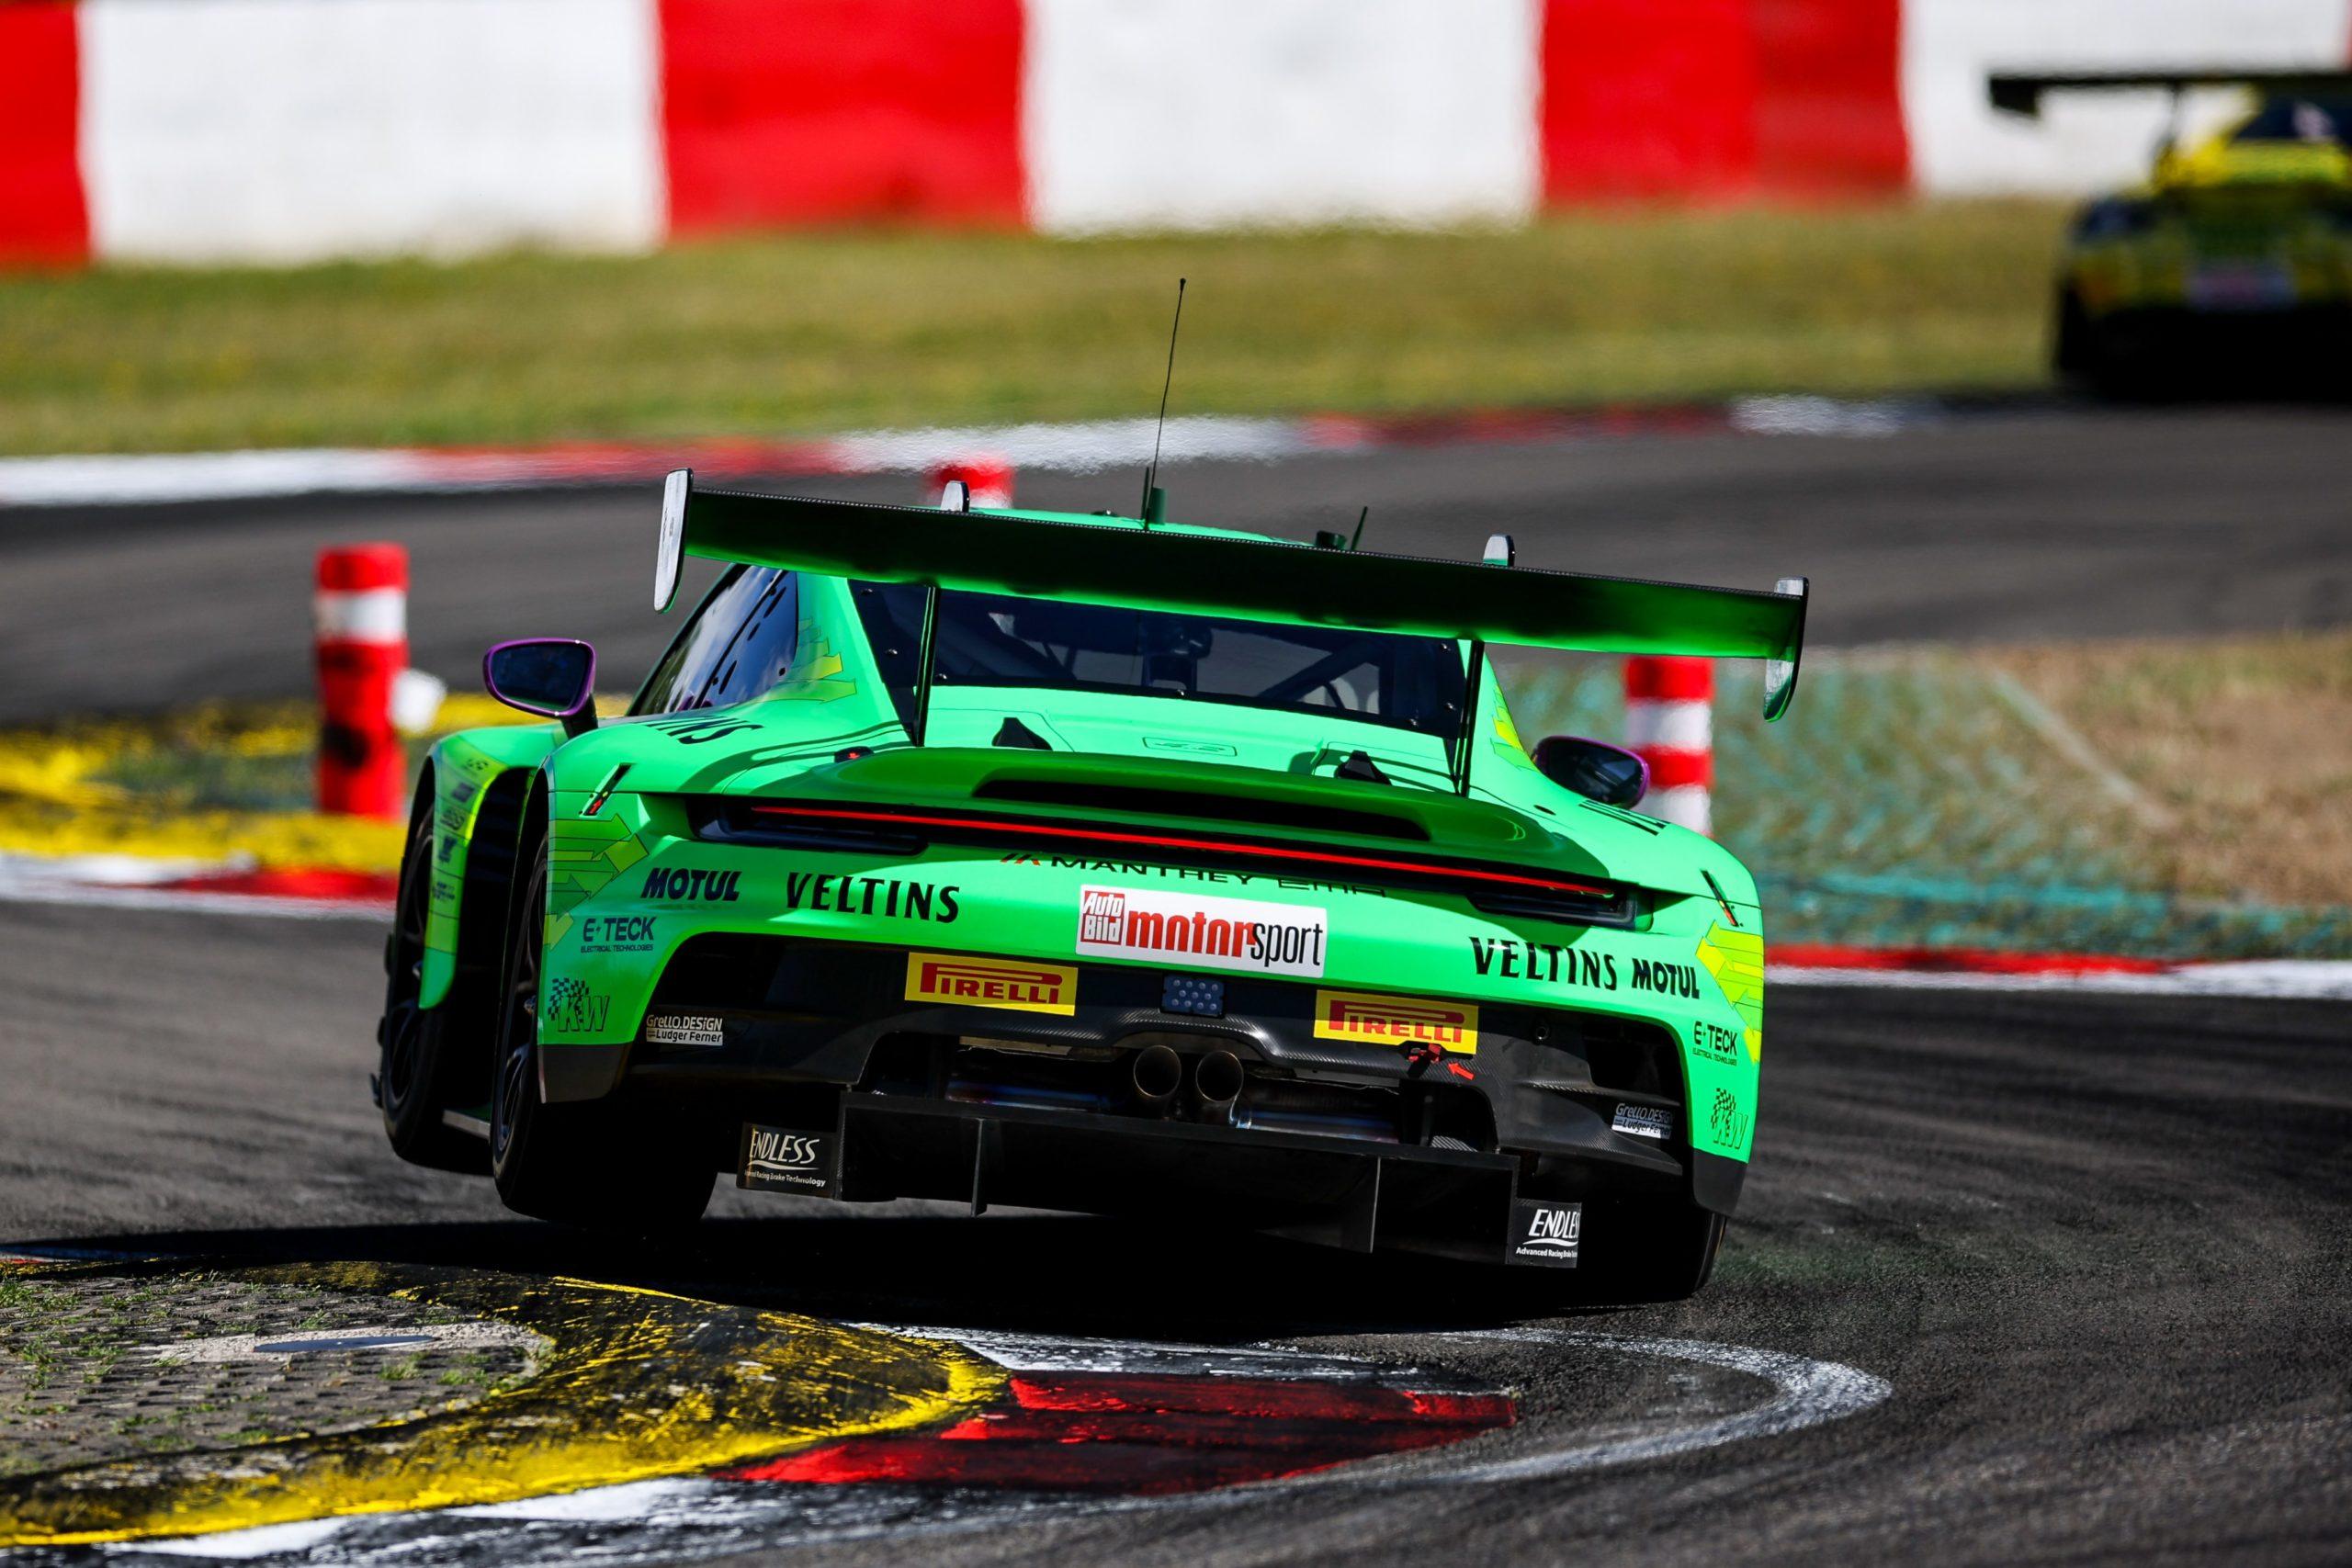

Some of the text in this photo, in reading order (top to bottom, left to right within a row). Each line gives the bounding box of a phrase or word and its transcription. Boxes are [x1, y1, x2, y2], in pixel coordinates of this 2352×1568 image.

[640, 868, 742, 902] MOTUL
[1051, 856, 1255, 885] MANTHEY
[786, 872, 960, 923] VELTINS
[1083, 892, 1125, 917] Auto
[1083, 915, 1122, 942] Bild
[613, 944, 653, 953] TECHNOLOGIES
[1469, 937, 1618, 991] VELTINS
[920, 962, 1063, 1004] PIRELLI
[1631, 958, 1701, 999] MOTUL
[558, 996, 610, 1032] KW
[1329, 1000, 1465, 1043] PIRELLI
[656, 1030, 721, 1043] Ludger Ferner
[1623, 1119, 1649, 1133] Ludger
[1712, 1107, 1748, 1149] KW
[750, 1128, 820, 1164] ENDLESS
[786, 1175, 826, 1187] Technology
[1516, 1247, 1548, 1257] Advanced
[1548, 1248, 1564, 1258] Racing
